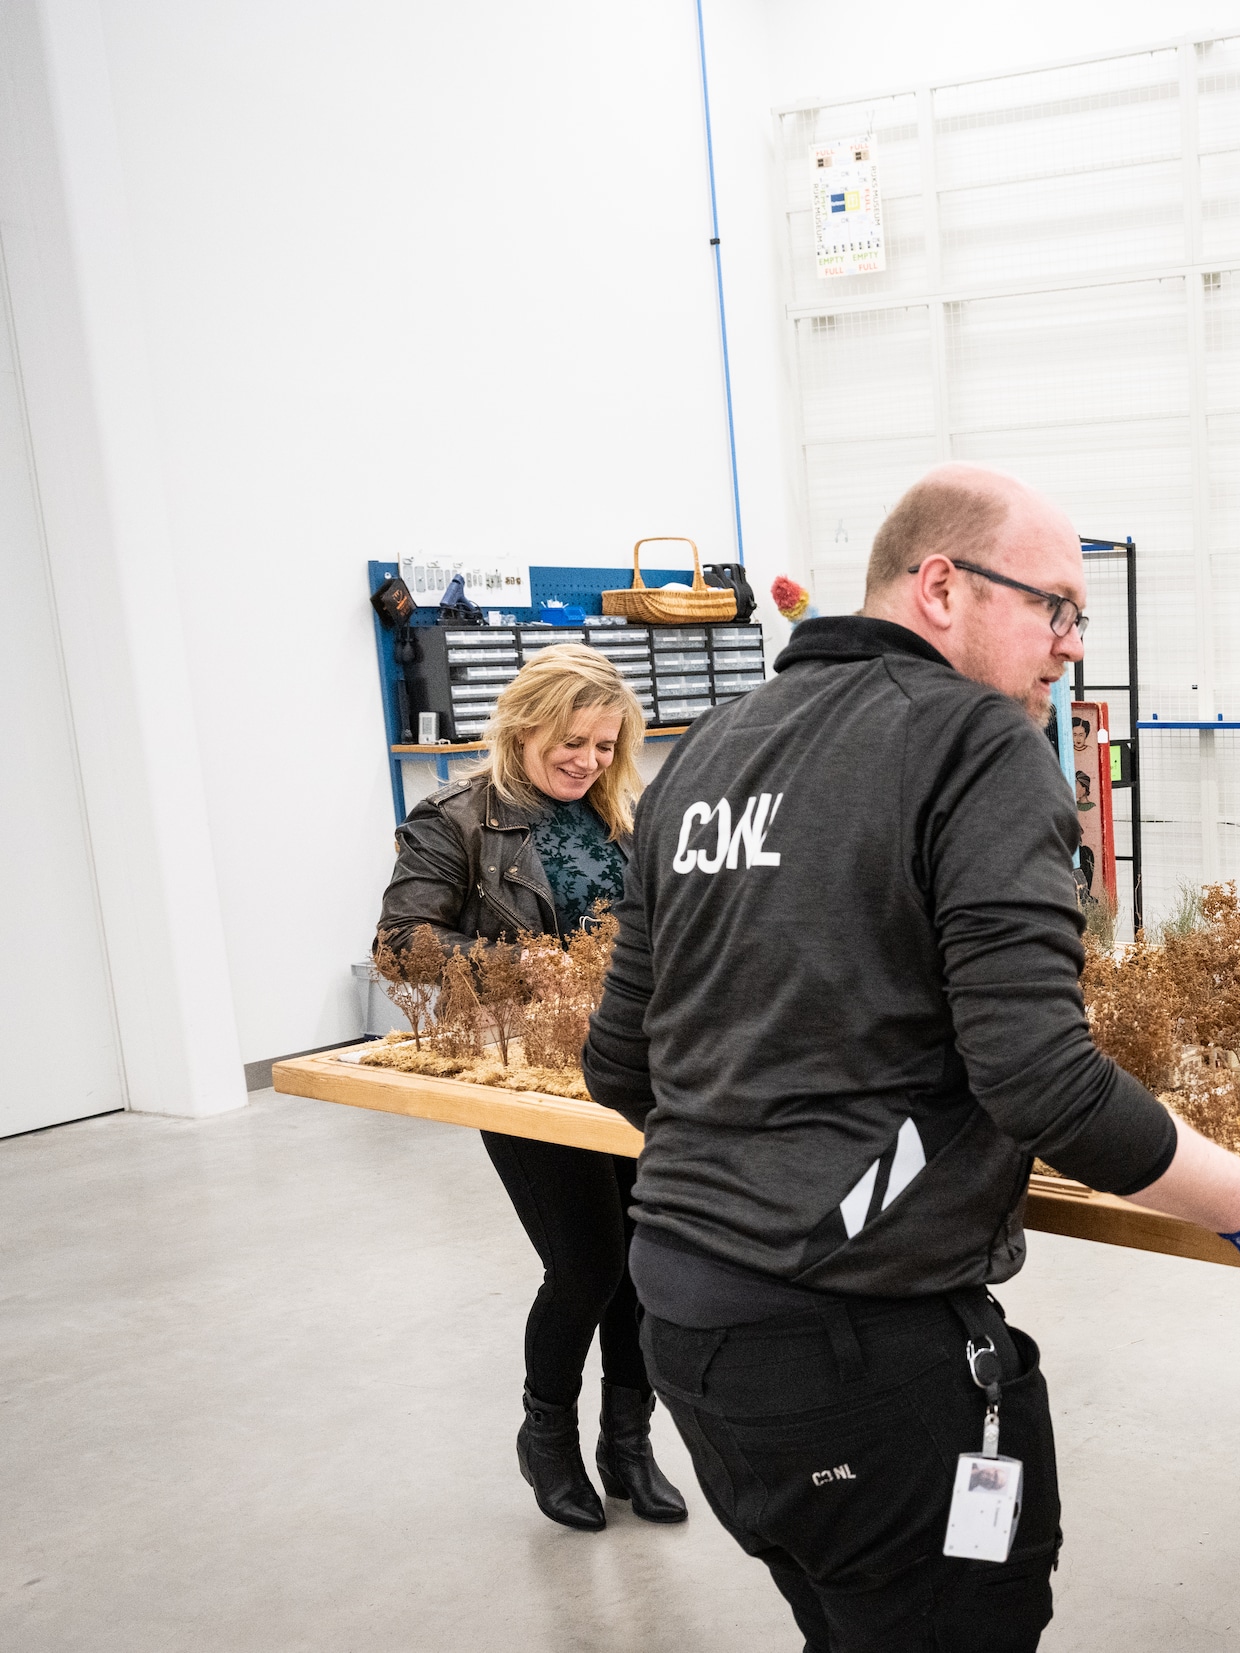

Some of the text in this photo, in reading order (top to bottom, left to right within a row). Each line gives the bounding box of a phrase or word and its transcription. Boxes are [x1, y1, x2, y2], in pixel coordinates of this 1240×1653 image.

[818, 255, 845, 266] EMPTY
[852, 251, 879, 262] EMPTY
[824, 267, 844, 276] FULL
[858, 262, 878, 271] FULL
